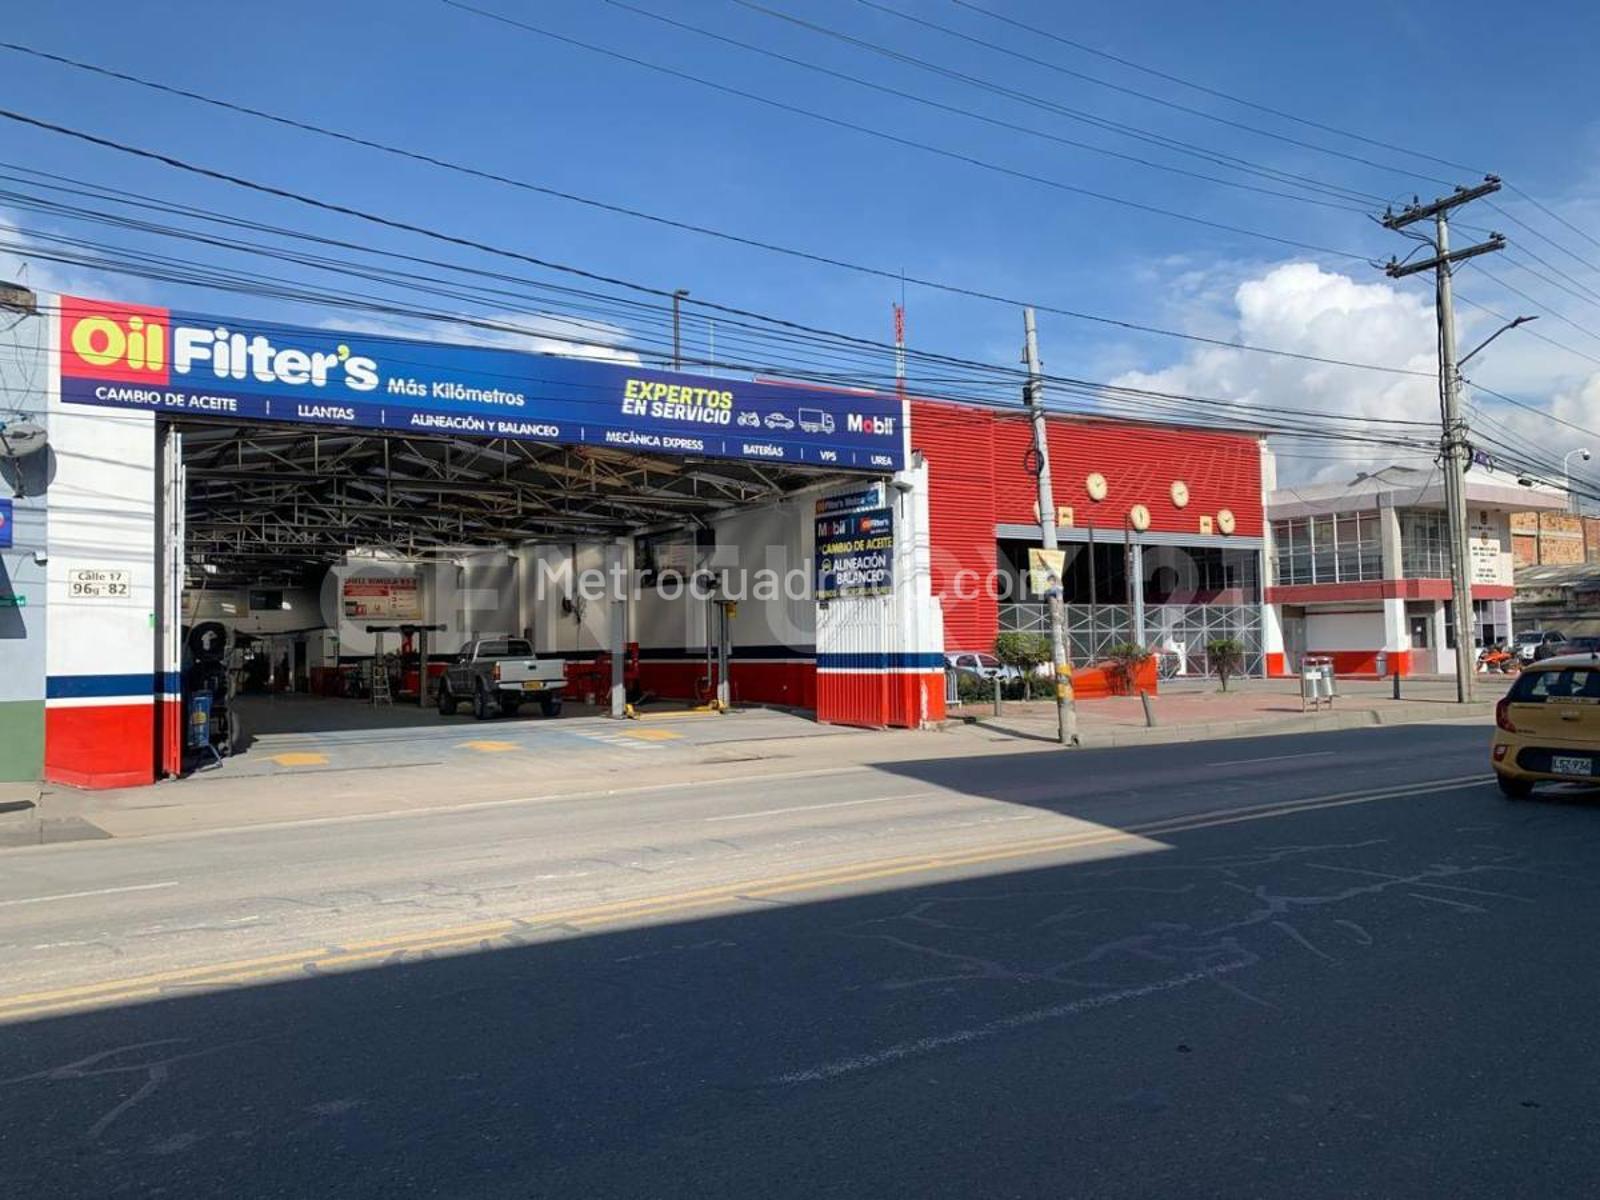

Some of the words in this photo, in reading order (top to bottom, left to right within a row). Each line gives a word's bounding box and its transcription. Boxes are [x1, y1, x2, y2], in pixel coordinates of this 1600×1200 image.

[71, 315, 164, 371] Oil
[174, 326, 379, 391] Filter's
[95, 386, 161, 405] CAMBIO
[165, 393, 184, 407] DE
[188, 395, 238, 412] ACEITE
[387, 377, 427, 397] Más
[432, 382, 525, 406] Kilómetros
[624, 379, 733, 409] EXPERTOS
[298, 404, 355, 420] LLANTAS
[621, 398, 648, 416] EN
[651, 401, 731, 425] SERVICIO
[411, 413, 485, 432] ALINEACIÓN
[487, 421, 497, 432] Y
[498, 421, 559, 437] BALANCEO
[847, 413, 894, 436] Mobil
[605, 430, 661, 447] MECÁNICA
[663, 436, 704, 451] EXPRESS
[743, 444, 784, 457] BATERÍAS
[820, 450, 837, 462] VPS
[871, 455, 893, 466] UREA
[822, 541, 853, 555] CAMBIO
[854, 539, 866, 551] DE
[866, 536, 893, 550] ACEITE
[833, 551, 887, 572] ALINEACIÓN
[77, 571, 106, 581] Calle
[836, 568, 885, 585] BALANCEO
